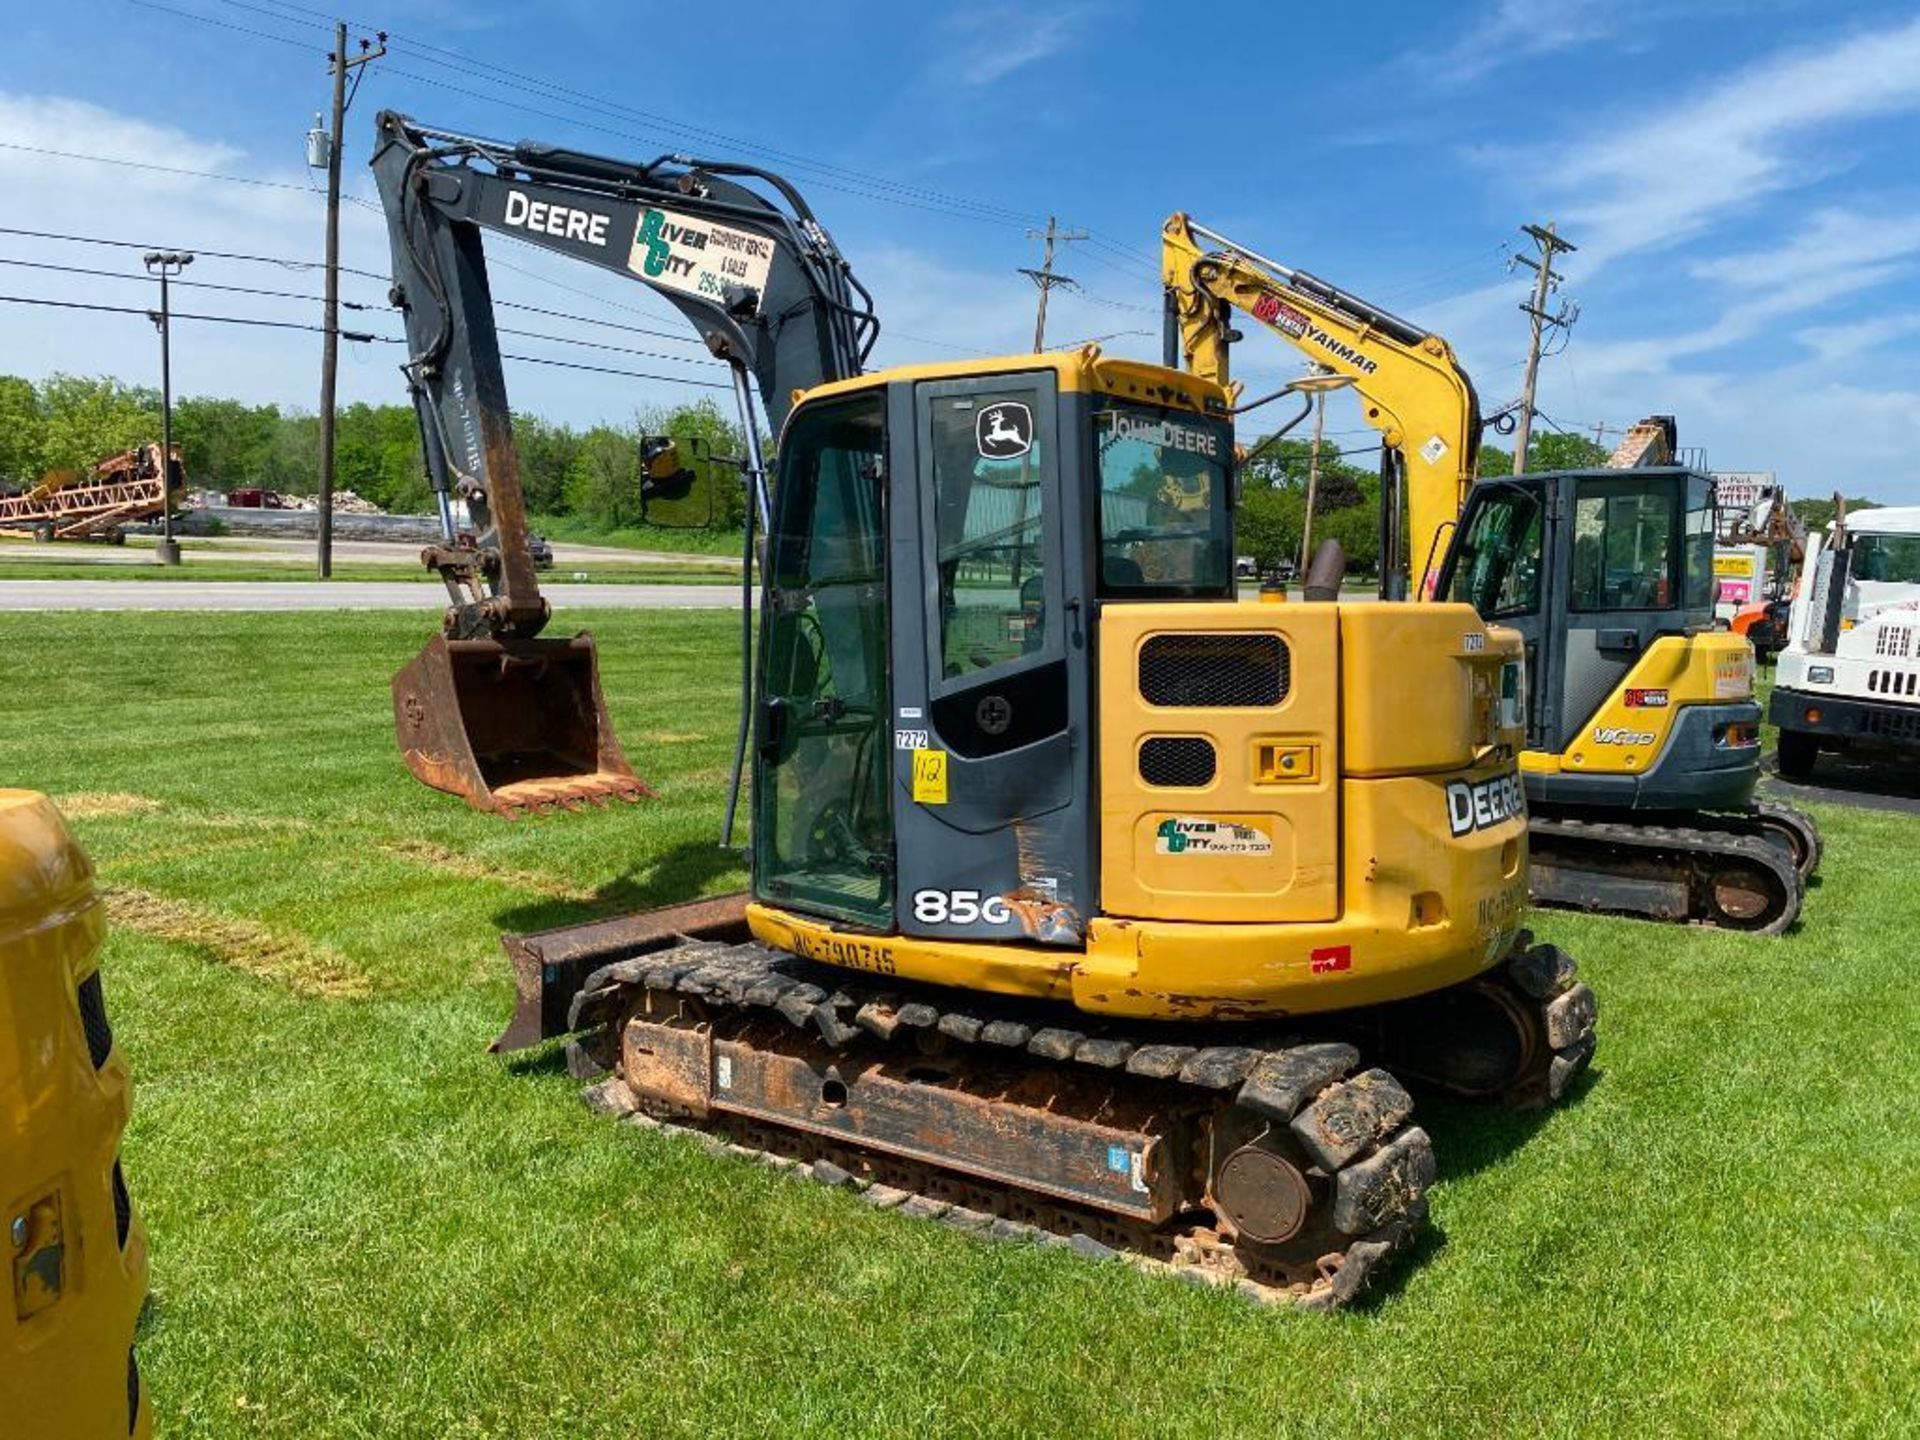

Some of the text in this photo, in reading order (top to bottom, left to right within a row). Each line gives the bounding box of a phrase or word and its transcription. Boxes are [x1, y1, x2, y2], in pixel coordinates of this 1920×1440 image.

[505, 191, 611, 246] DEERE
[637, 208, 709, 251] RIVER
[644, 238, 697, 277] CITY
[1308, 326, 1378, 375] YANMAR
[1161, 421, 1217, 457] DEERE
[896, 732, 926, 748] 7272
[1447, 775, 1524, 835] DEERE
[914, 889, 1011, 924] 85G
